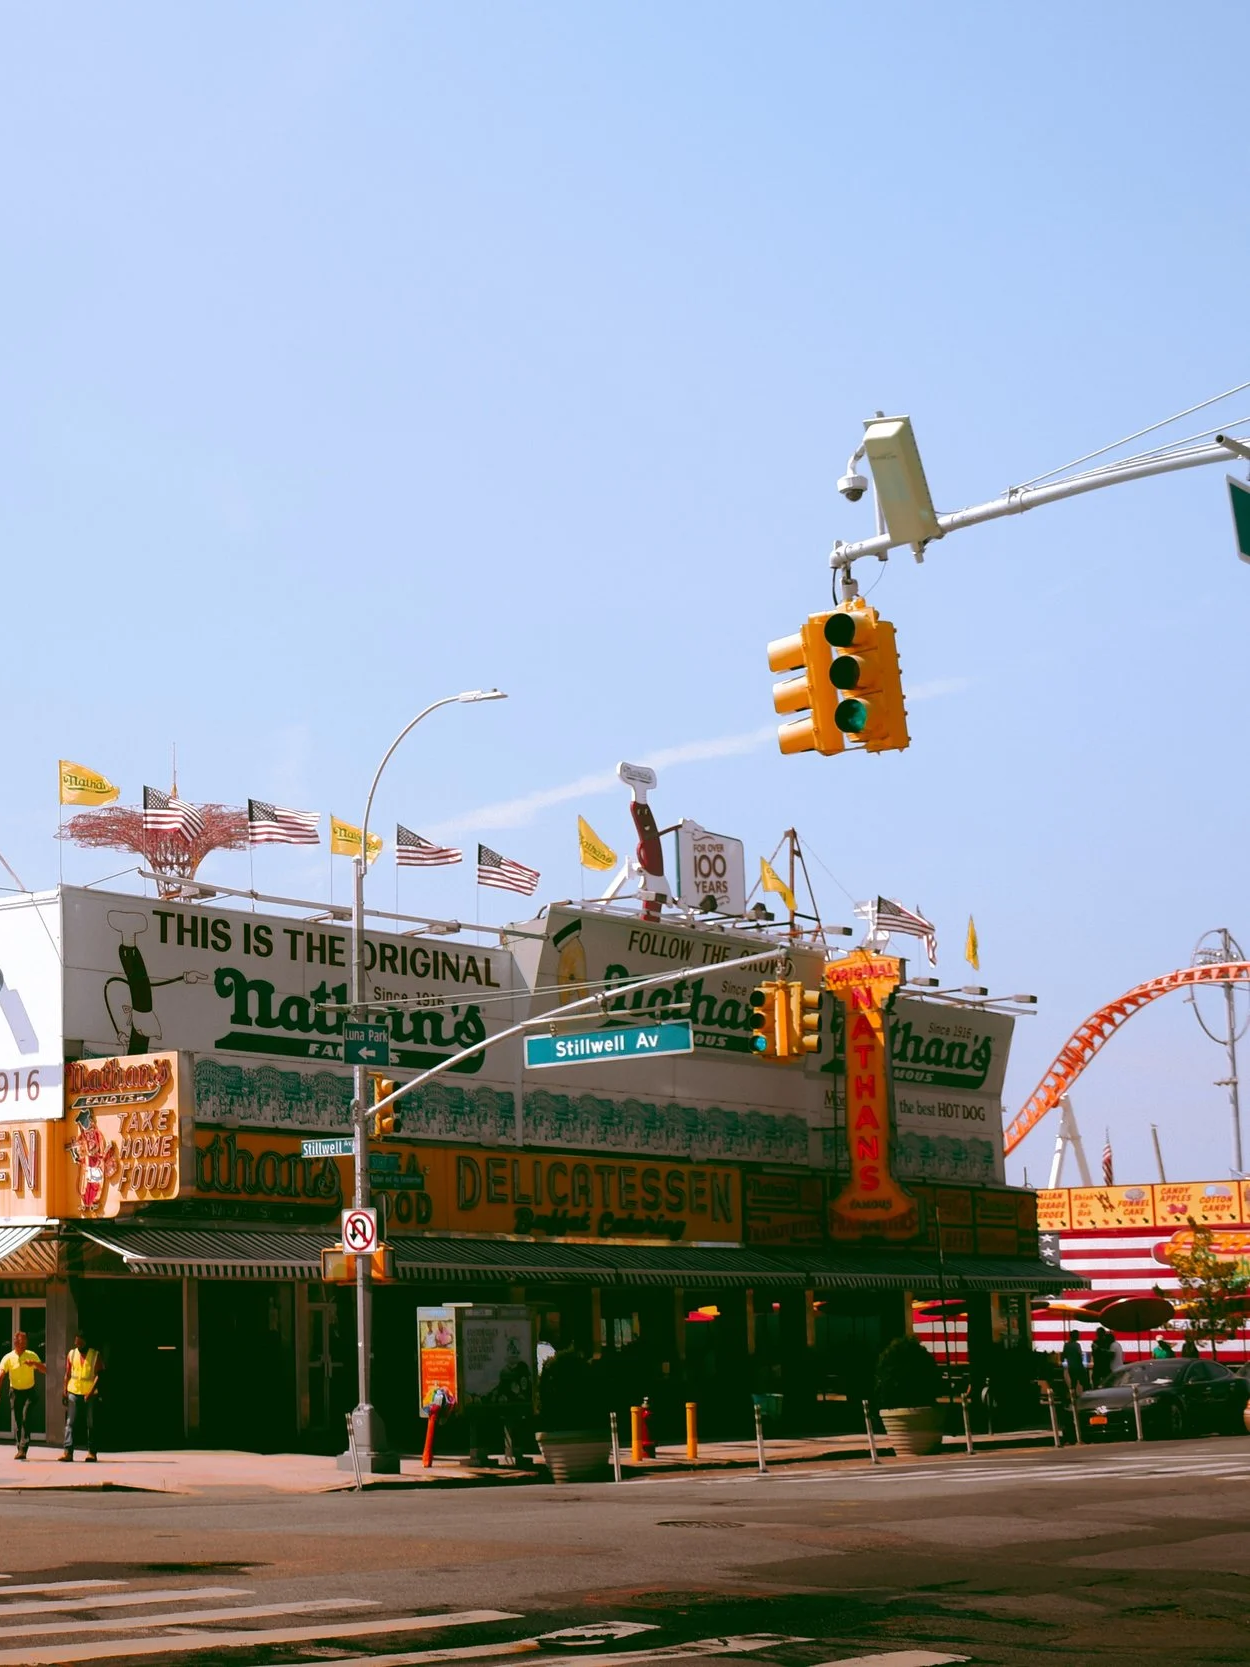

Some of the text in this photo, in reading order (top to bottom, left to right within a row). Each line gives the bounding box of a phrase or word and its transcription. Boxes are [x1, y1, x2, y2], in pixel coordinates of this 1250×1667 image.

[693, 844, 725, 852] FOR OVER
[694, 854, 726, 878] 100
[694, 881, 728, 894] YEARS
[153, 910, 501, 988] THIS IS THE ORIGINAL
[628, 930, 695, 960] FOLLOW
[373, 986, 409, 1003] Since
[345, 1028, 388, 1042] Luna Park
[555, 1033, 659, 1058] Stillwell Av
[65, 1058, 171, 1093] Nathan's
[118, 1109, 171, 1133] TAKE
[899, 1101, 986, 1121] the best HOT DOG
[119, 1135, 174, 1159] HOME
[302, 1141, 343, 1155] Stillwell
[118, 1162, 174, 1192] FOOD
[456, 1154, 734, 1225] DELICATESSEN
